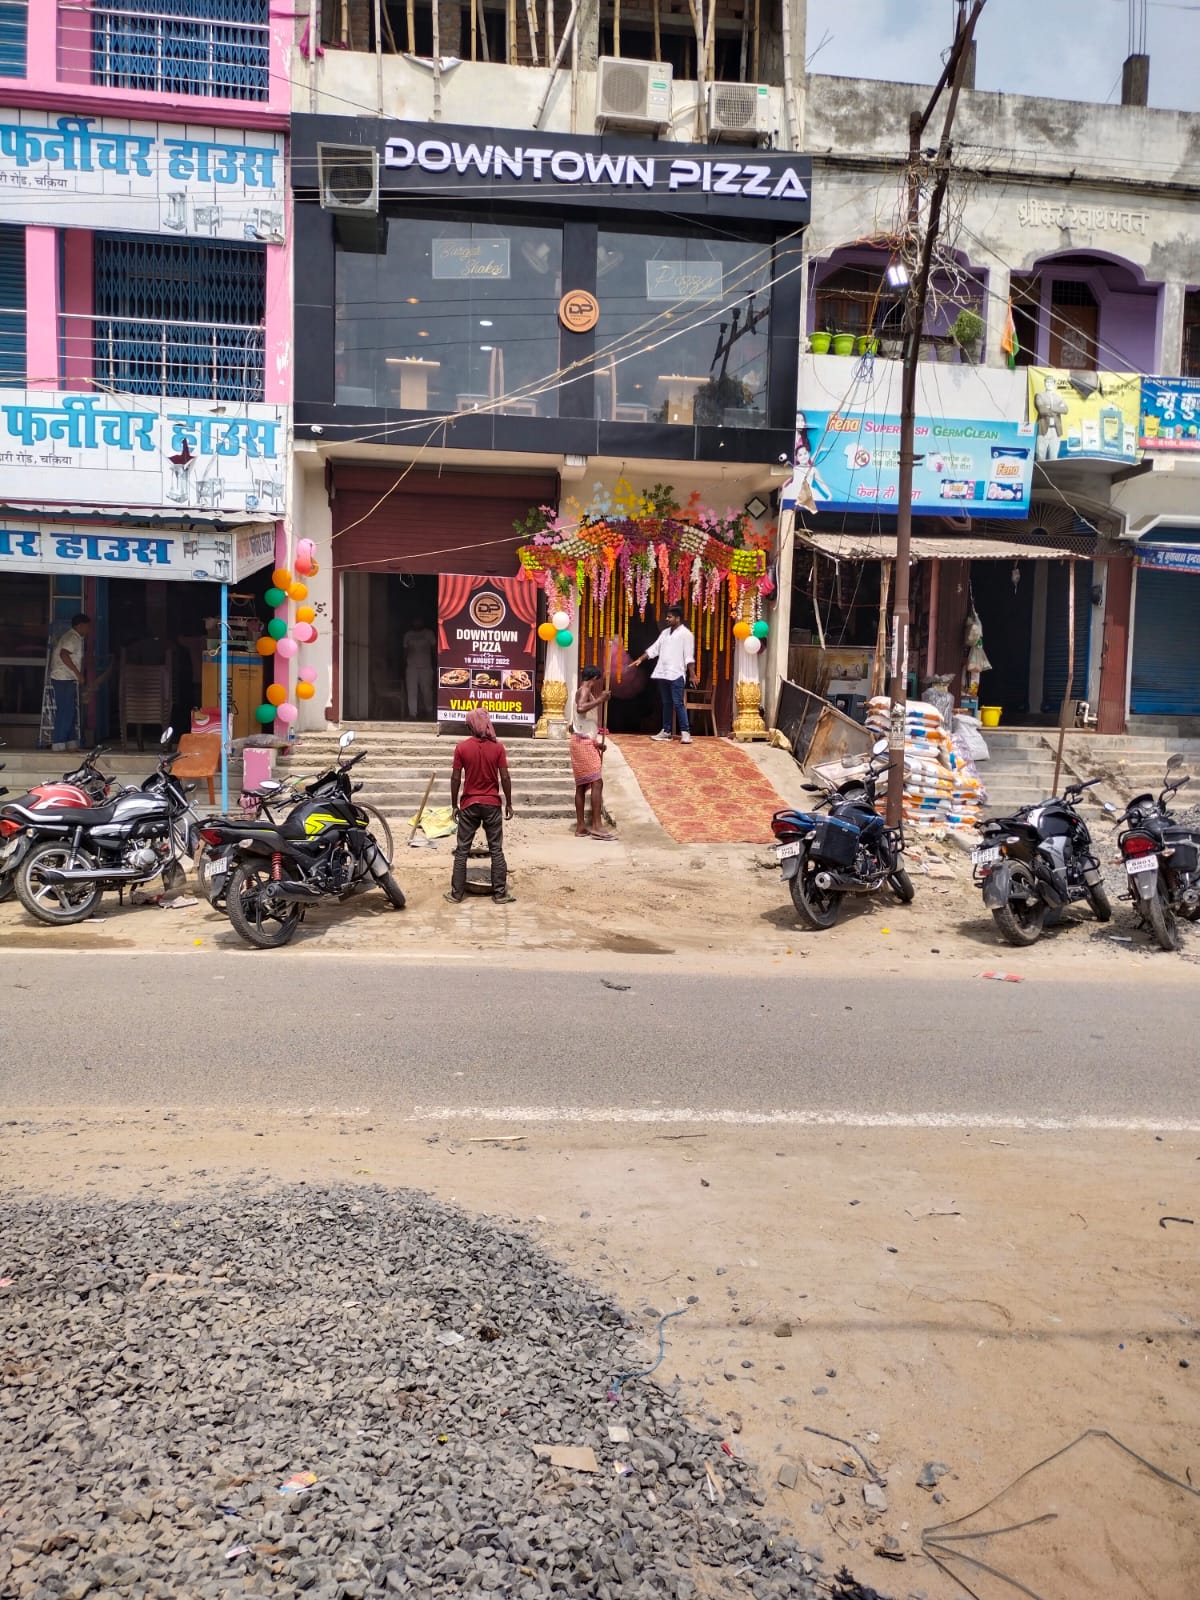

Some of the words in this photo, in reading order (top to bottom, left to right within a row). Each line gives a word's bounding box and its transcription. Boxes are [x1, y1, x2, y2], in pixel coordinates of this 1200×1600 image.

[163, 138, 280, 188] हाउस
[384, 137, 655, 188] DOWNTOWN
[669, 159, 808, 199] PIZZA
[864, 421, 929, 435] SUPERSH
[167, 414, 281, 459] हाउस
[883, 483, 896, 498] ही
[51, 533, 174, 564] हाउस
[456, 629, 518, 642] DOWNTOWN
[472, 641, 501, 653] PIZZA
[469, 690, 475, 698] A
[477, 690, 492, 699] Unit
[450, 699, 479, 710] VIJAY
[481, 700, 522, 712] GROUPS
